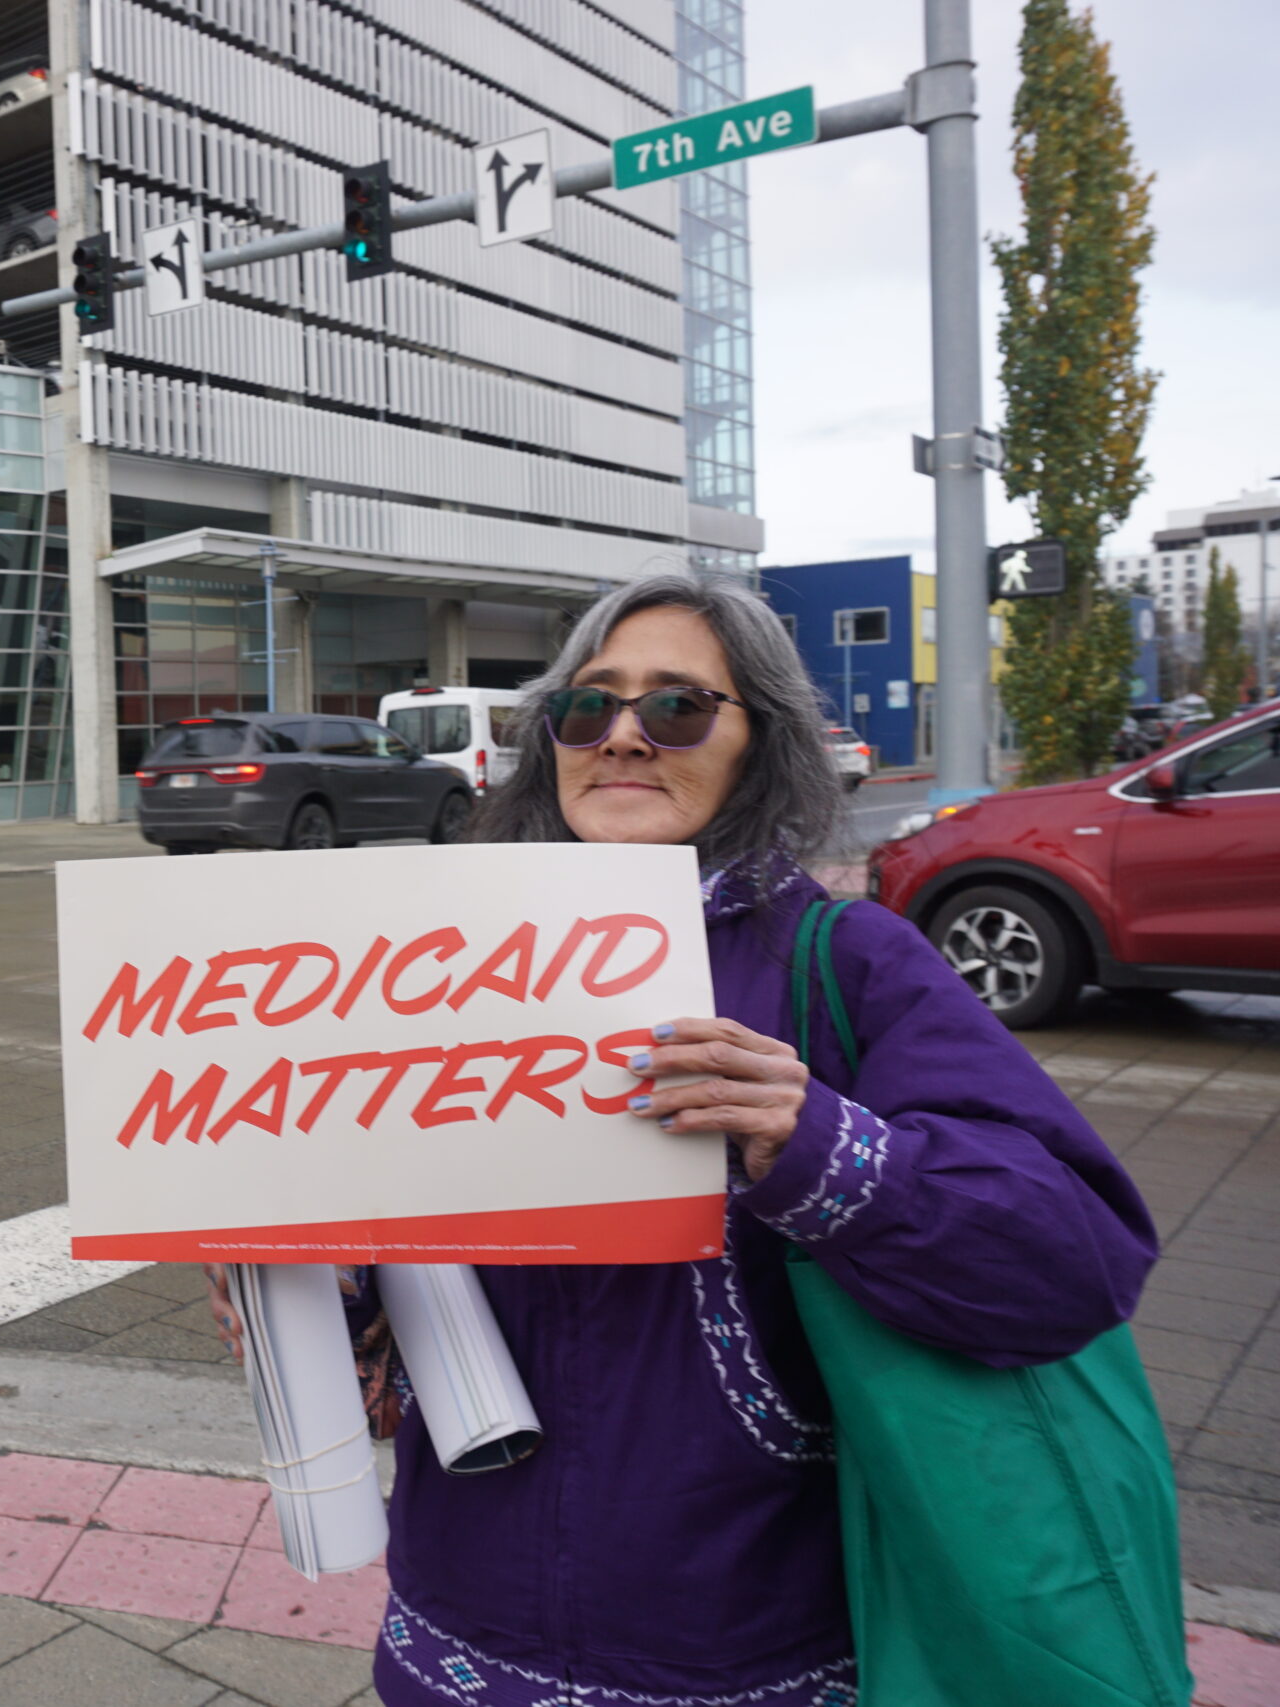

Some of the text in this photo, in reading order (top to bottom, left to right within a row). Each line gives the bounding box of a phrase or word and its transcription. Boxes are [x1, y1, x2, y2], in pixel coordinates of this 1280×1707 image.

[632, 110, 793, 173] 7th Ave
[82, 913, 669, 1043] MEDICAID
[116, 1028, 657, 1150] MATTERS
